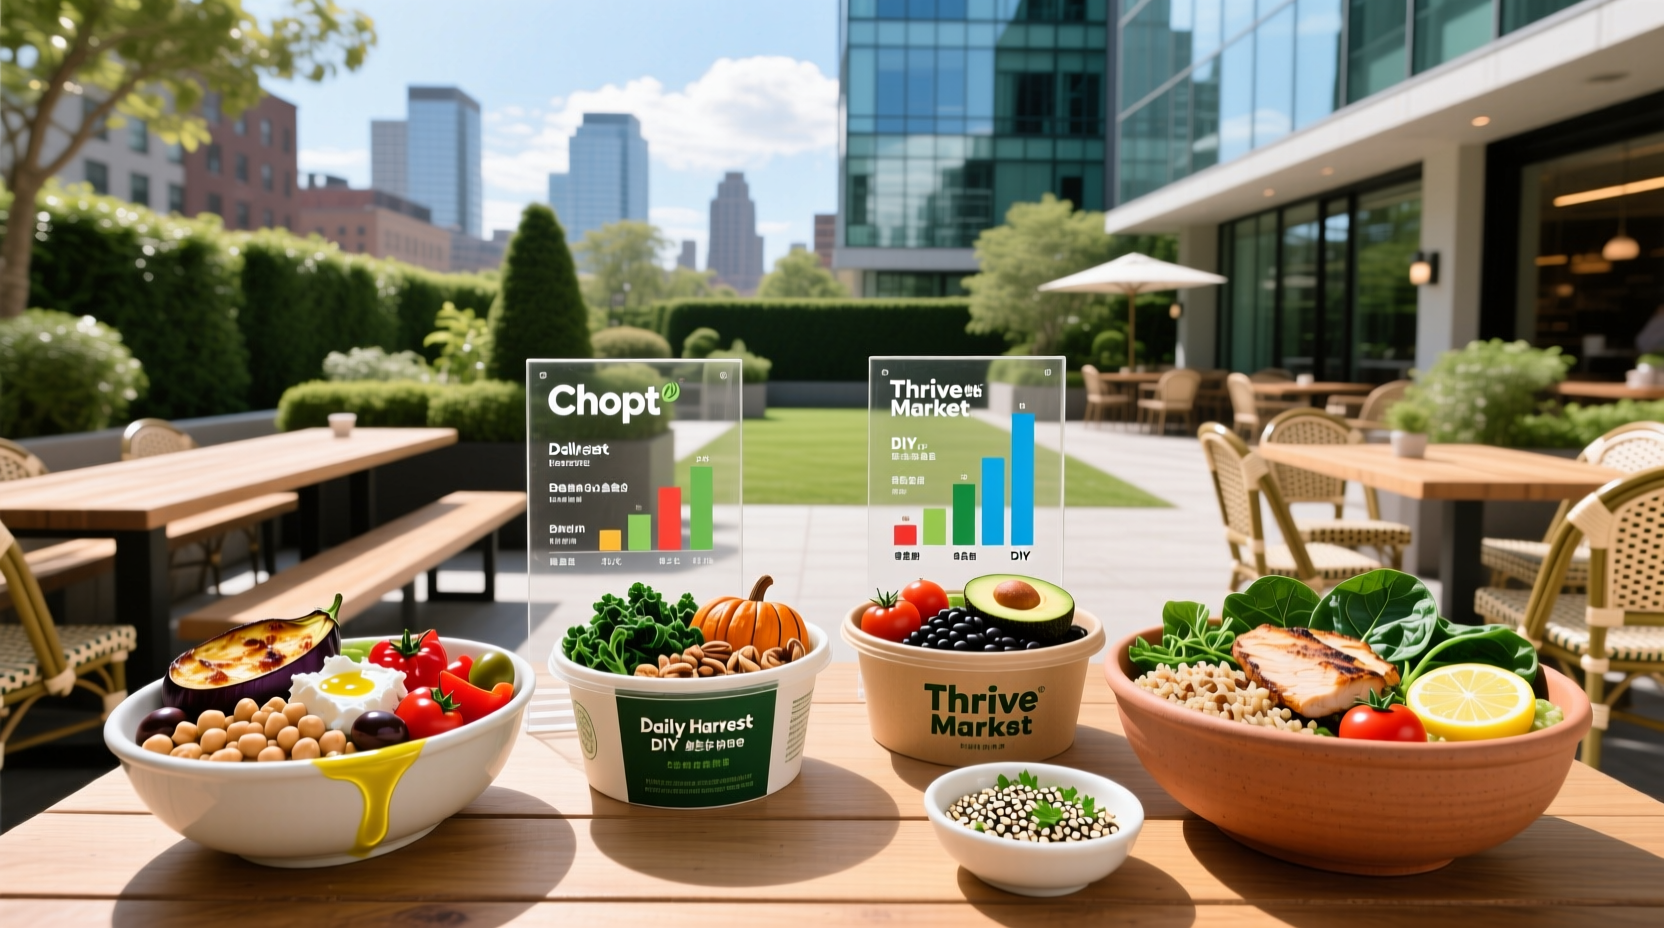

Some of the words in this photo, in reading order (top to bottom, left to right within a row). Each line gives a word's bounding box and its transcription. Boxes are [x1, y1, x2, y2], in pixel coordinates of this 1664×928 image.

[890, 378, 963, 398] Thrive
[548, 384, 661, 424] Chopt
[891, 399, 970, 417] Market
[891, 437, 917, 450] DIY
[1010, 551, 1031, 561] DIY
[924, 683, 1038, 714] Thrive
[640, 717, 686, 739] Daily
[689, 714, 753, 734] Harvest
[651, 738, 679, 752] DIY
